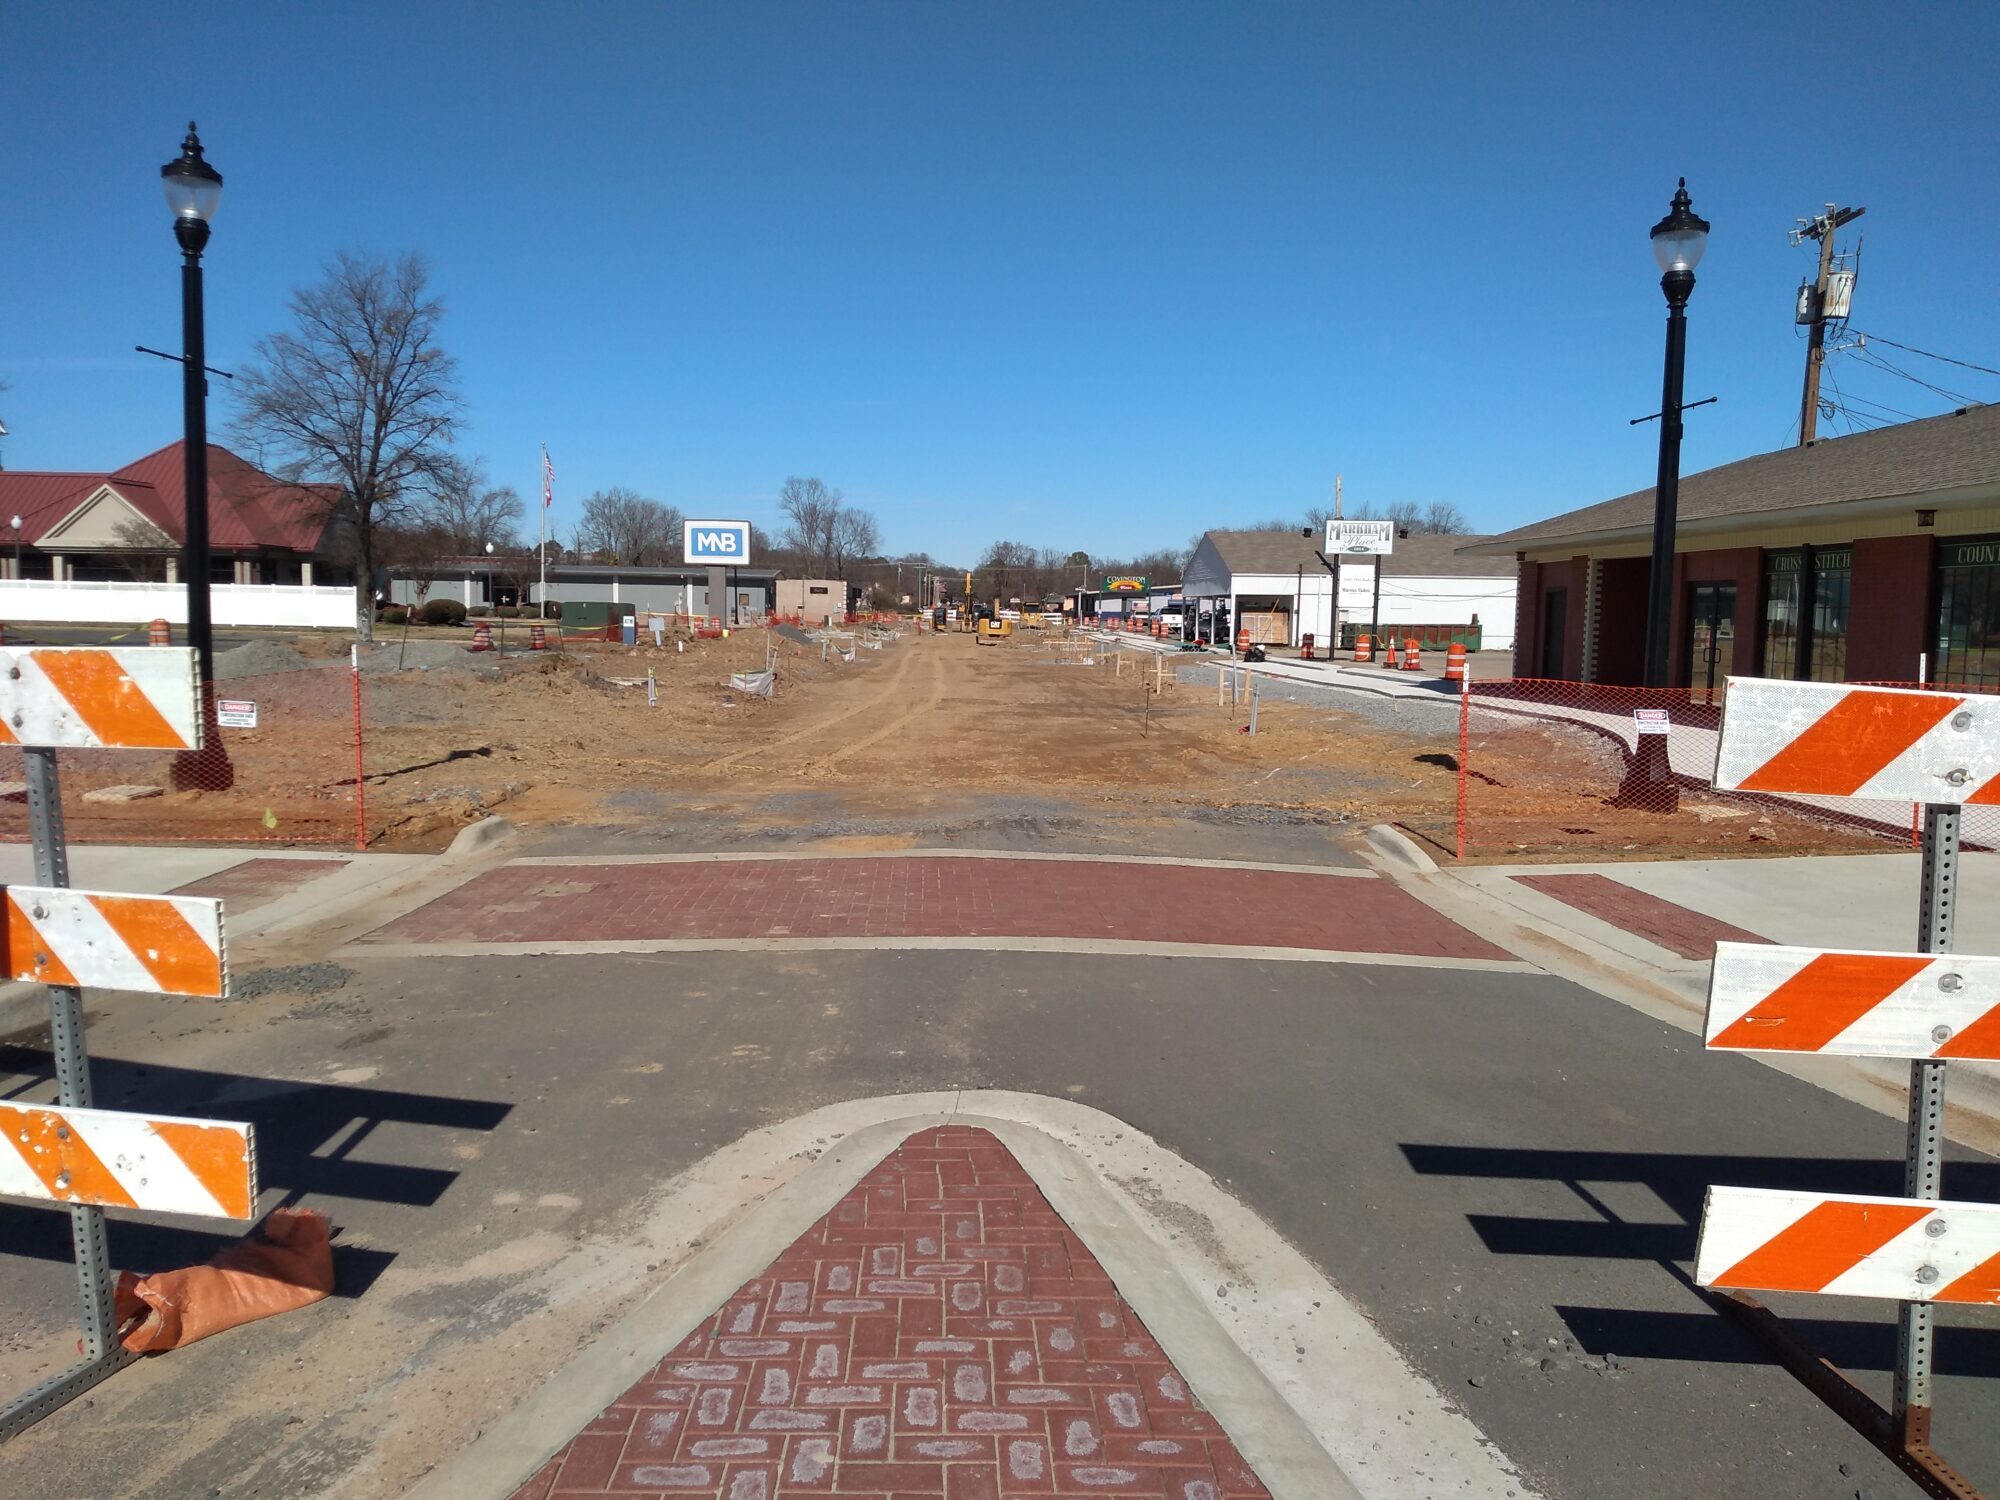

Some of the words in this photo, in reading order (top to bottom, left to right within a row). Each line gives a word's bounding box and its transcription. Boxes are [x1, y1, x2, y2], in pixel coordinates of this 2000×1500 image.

[1329, 523, 1391, 541] MARKHAM
[697, 531, 737, 552] MNB
[1343, 535, 1376, 547] Place
[1814, 552, 1851, 569] STITCH
